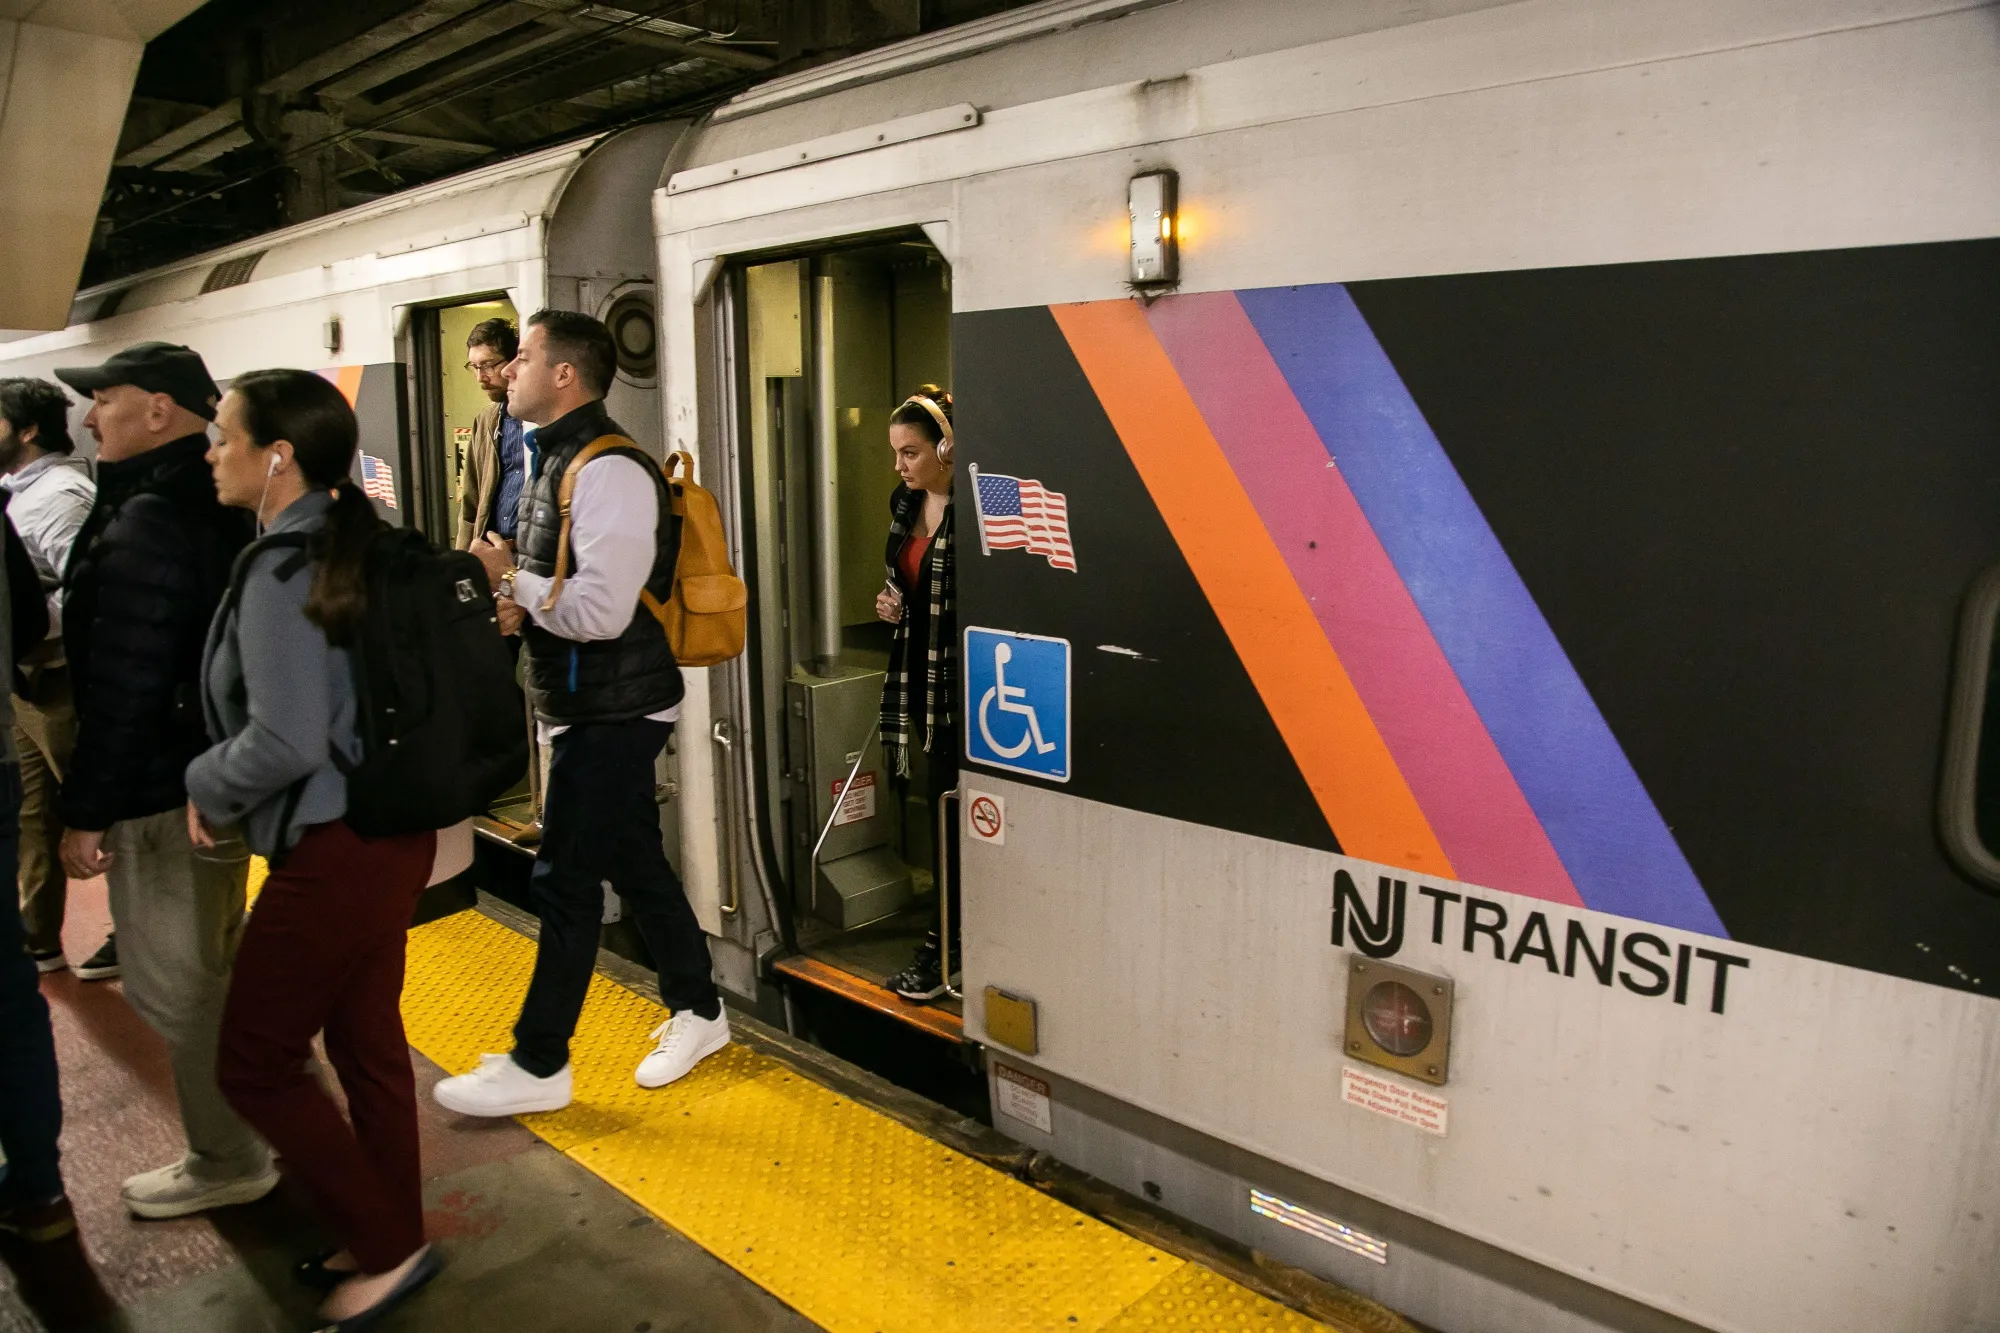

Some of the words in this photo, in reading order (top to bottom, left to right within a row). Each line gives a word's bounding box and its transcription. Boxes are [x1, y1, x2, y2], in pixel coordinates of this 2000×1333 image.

[1330, 869, 1407, 959] NJ
[1419, 885, 1751, 1015] TRANSIT
[1343, 1071, 1387, 1092] Emergency
[1389, 1084, 1409, 1098] Door
[1399, 1111, 1418, 1122] Door
